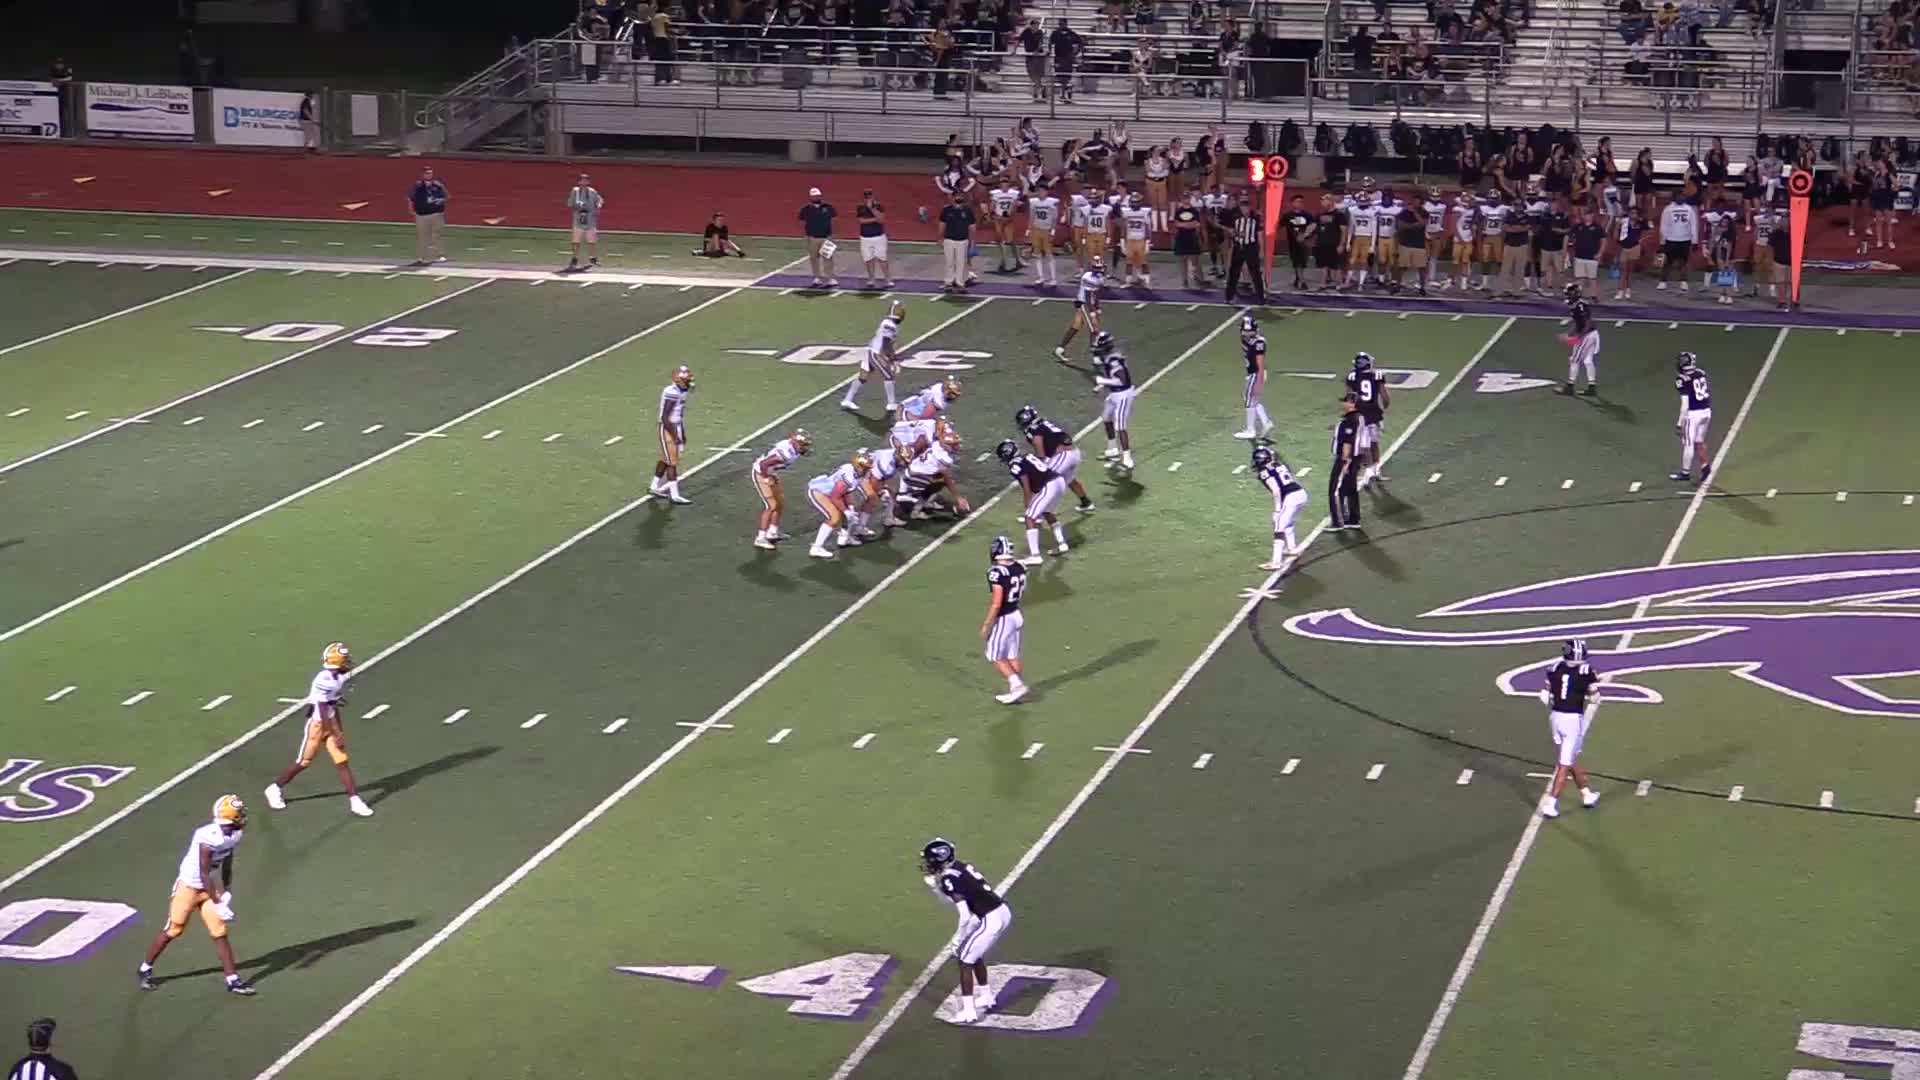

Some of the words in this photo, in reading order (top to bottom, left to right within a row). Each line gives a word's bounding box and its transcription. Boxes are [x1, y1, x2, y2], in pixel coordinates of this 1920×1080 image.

[89, 84, 130, 97] Michael
[145, 87, 189, 100] LeBlanc
[1251, 159, 1265, 181] 3
[1360, 379, 1373, 402] 9
[1692, 376, 1709, 401] 82
[1560, 673, 1570, 700] 1
